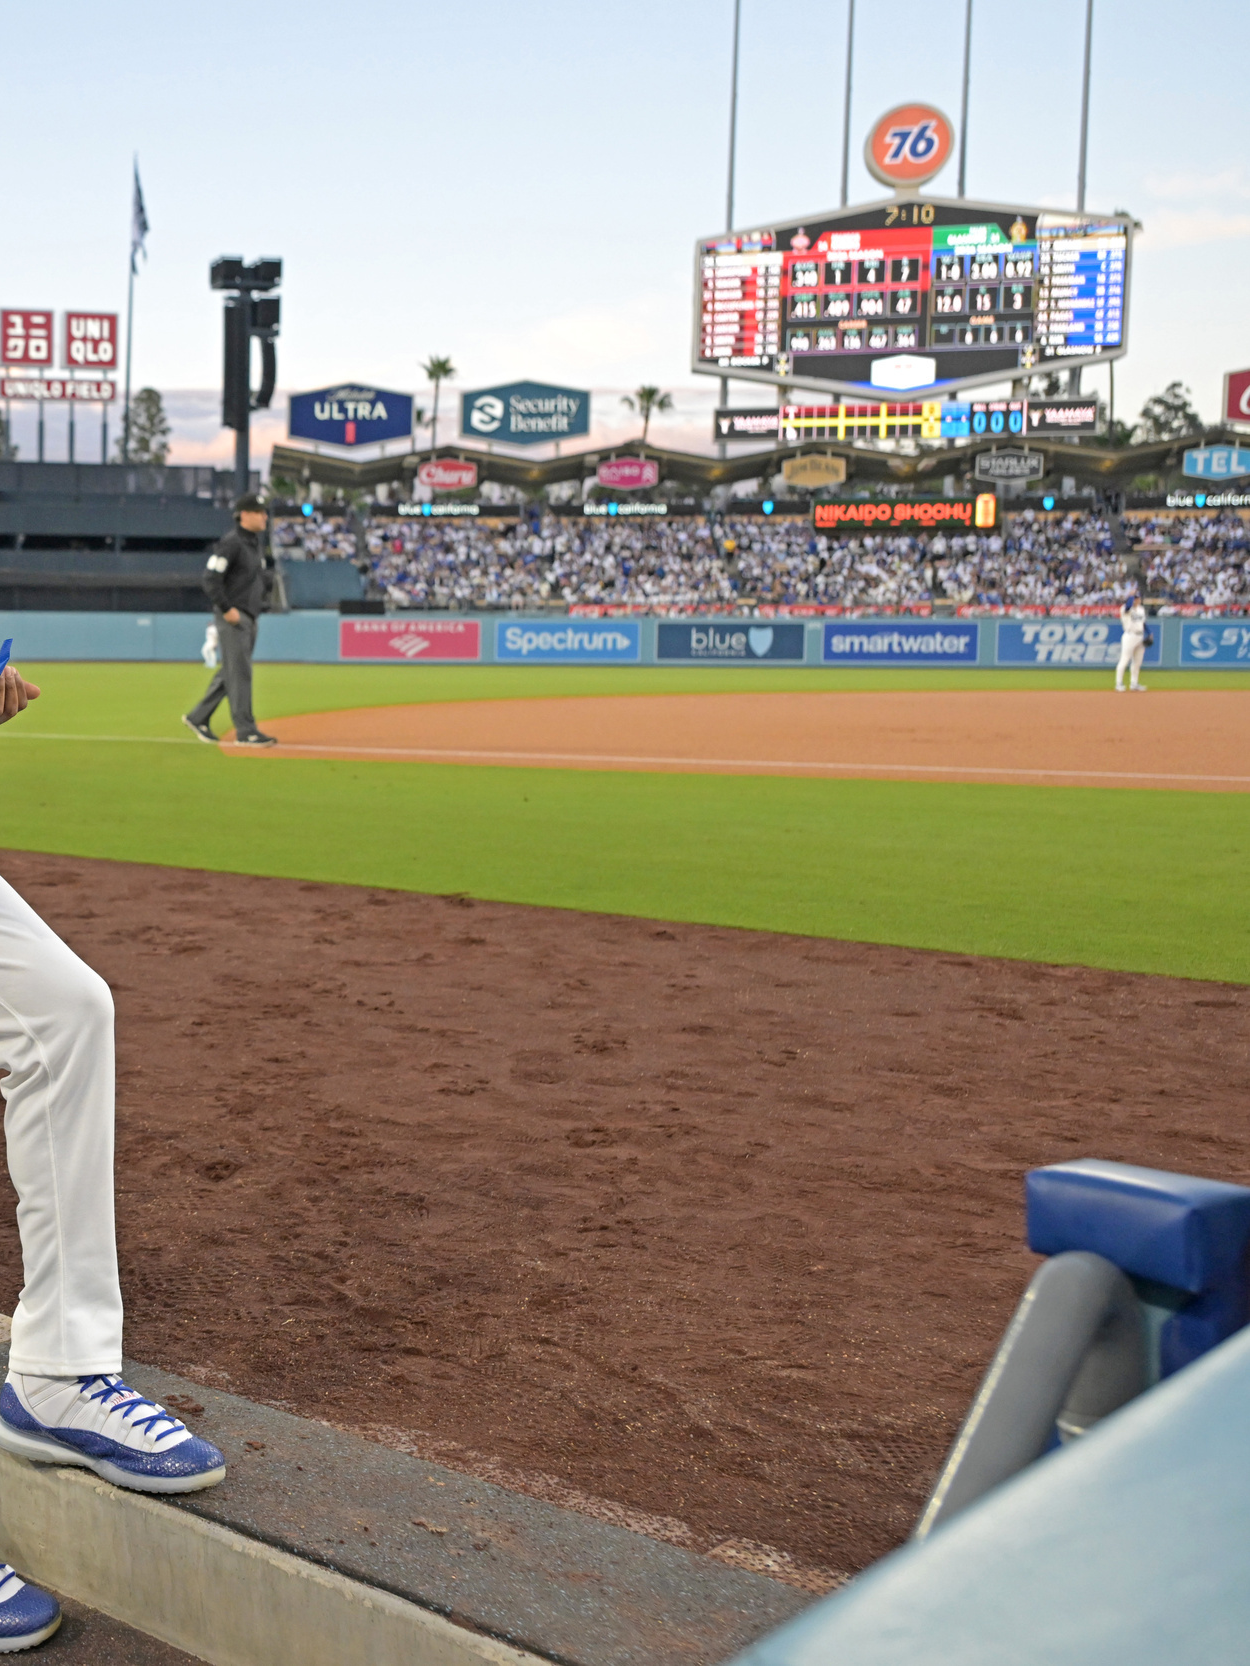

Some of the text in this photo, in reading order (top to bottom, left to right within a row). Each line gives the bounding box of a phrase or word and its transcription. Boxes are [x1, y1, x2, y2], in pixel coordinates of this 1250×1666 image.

[887, 121, 937, 162] 76
[885, 204, 935, 226] 7:10
[70, 317, 110, 340] UNI
[70, 339, 113, 364] QLO
[4, 381, 113, 399] UNIQLO FIELD
[314, 401, 388, 420] ULTRA
[510, 394, 580, 418] Security
[511, 413, 570, 433] Benefit
[1191, 450, 1246, 474] TEL
[420, 463, 474, 485] Churu
[398, 502, 480, 516] blue california
[584, 502, 667, 515] blue california
[1166, 494, 1193, 507] blue
[815, 503, 892, 521] NIKAIDO
[354, 621, 465, 633] BANK OF AMERICA
[1021, 623, 1109, 643] TOYO
[505, 626, 625, 655] Spectrum
[691, 626, 747, 650] blue
[831, 631, 970, 653] smartwater
[1034, 642, 1122, 662] TIRES
